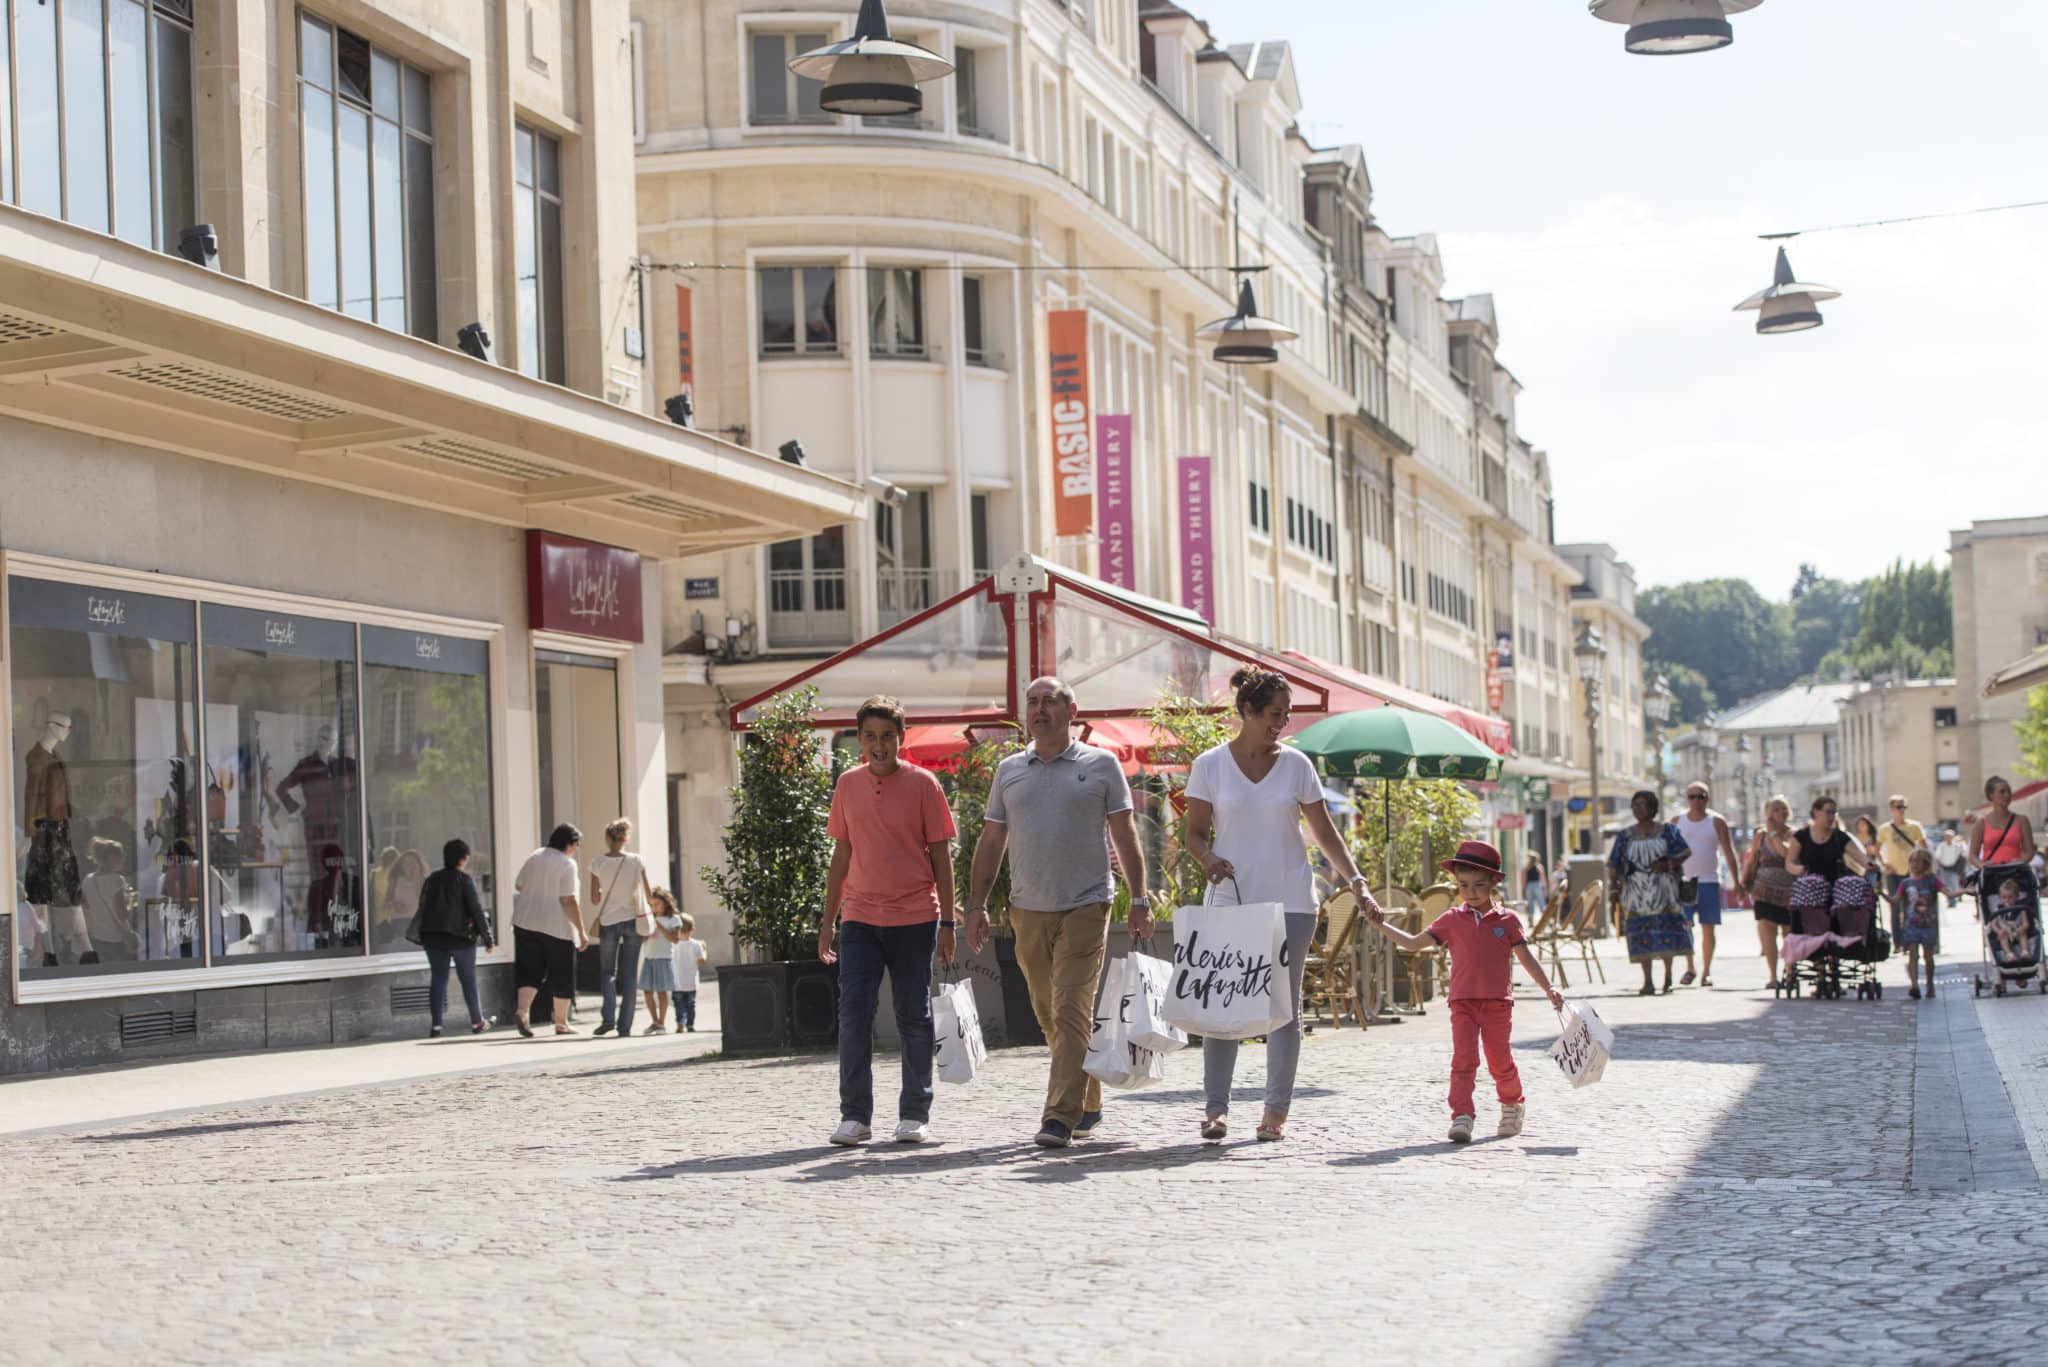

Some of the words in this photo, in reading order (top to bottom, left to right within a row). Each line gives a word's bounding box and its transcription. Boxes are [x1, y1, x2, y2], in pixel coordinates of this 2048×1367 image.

[1050, 352, 1092, 498] BASIC-FIT
[1107, 427, 1121, 508] THIERY
[1188, 468, 1202, 542] THIERY
[1353, 752, 1381, 775] Perrier
[1175, 954, 1272, 1009] Lafayette
